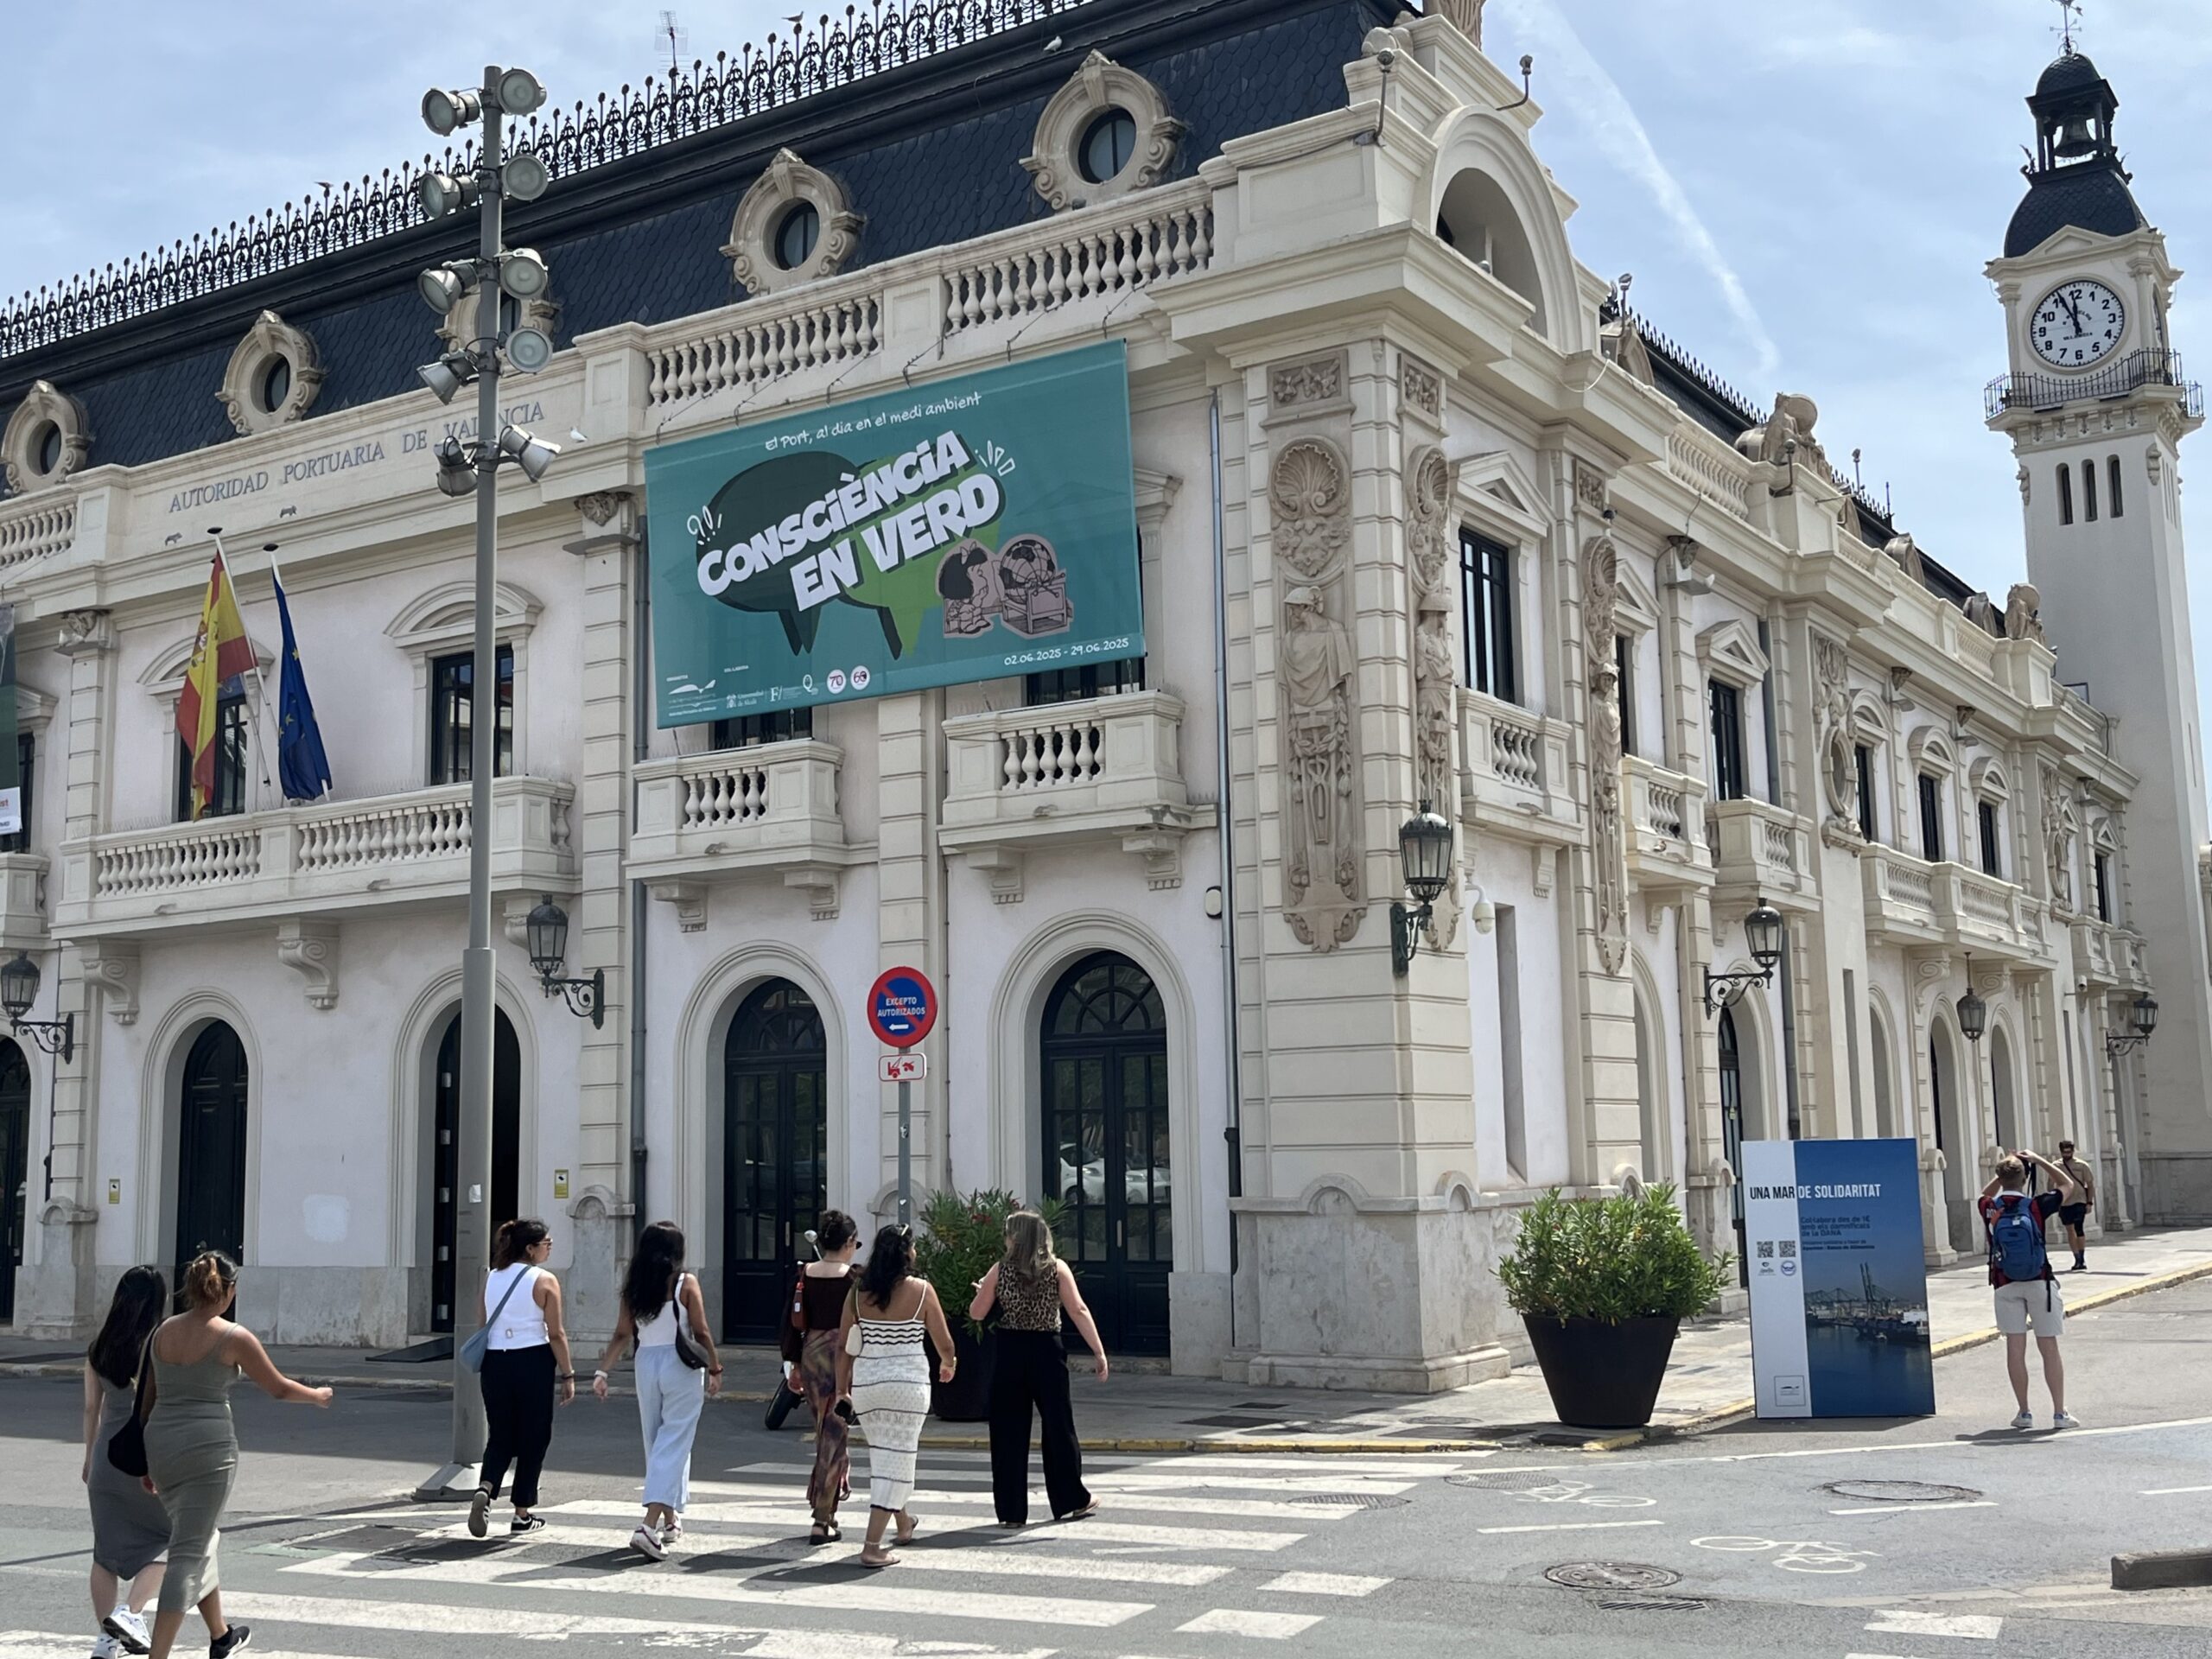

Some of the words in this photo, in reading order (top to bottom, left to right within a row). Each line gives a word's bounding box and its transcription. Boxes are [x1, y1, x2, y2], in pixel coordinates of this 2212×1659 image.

[2069, 289, 2082, 300] 12
[2088, 291, 2095, 302] 1
[2101, 299, 2110, 309] 2
[2041, 311, 2055, 322] 10
[2108, 313, 2116, 323] 3
[2038, 327, 2046, 337] 9
[2104, 329, 2112, 340] 4
[2044, 340, 2053, 351] 8
[2092, 341, 2100, 353] 5
[2059, 348, 2068, 359] 7
[2075, 350, 2083, 360] 6
[766, 439, 778, 451] El
[817, 426, 829, 440] al
[831, 421, 853, 436] dia
[856, 418, 872, 430] en
[874, 412, 887, 427] el
[890, 404, 922, 424] medi
[925, 391, 982, 416] ambient
[168, 471, 269, 513] AUTORIDAD
[283, 442, 385, 485] PORTUARIA
[402, 429, 428, 454] DE
[443, 401, 545, 441] VALNCIA
[790, 538, 858, 612] EN
[860, 474, 1000, 572] VERD
[1004, 648, 1061, 665] 02.06.2025
[1071, 638, 1128, 656] 29.06.2025
[830, 674, 843, 687] 70
[886, 996, 917, 1006] EXCEPTO
[877, 1007, 925, 1017] AUTORIZADOS
[1750, 1186, 1770, 1199] UNA
[1773, 1186, 1795, 1198] MAR
[1798, 1185, 1812, 1198] DE
[1815, 1184, 1881, 1198] SOLIDARITAT
